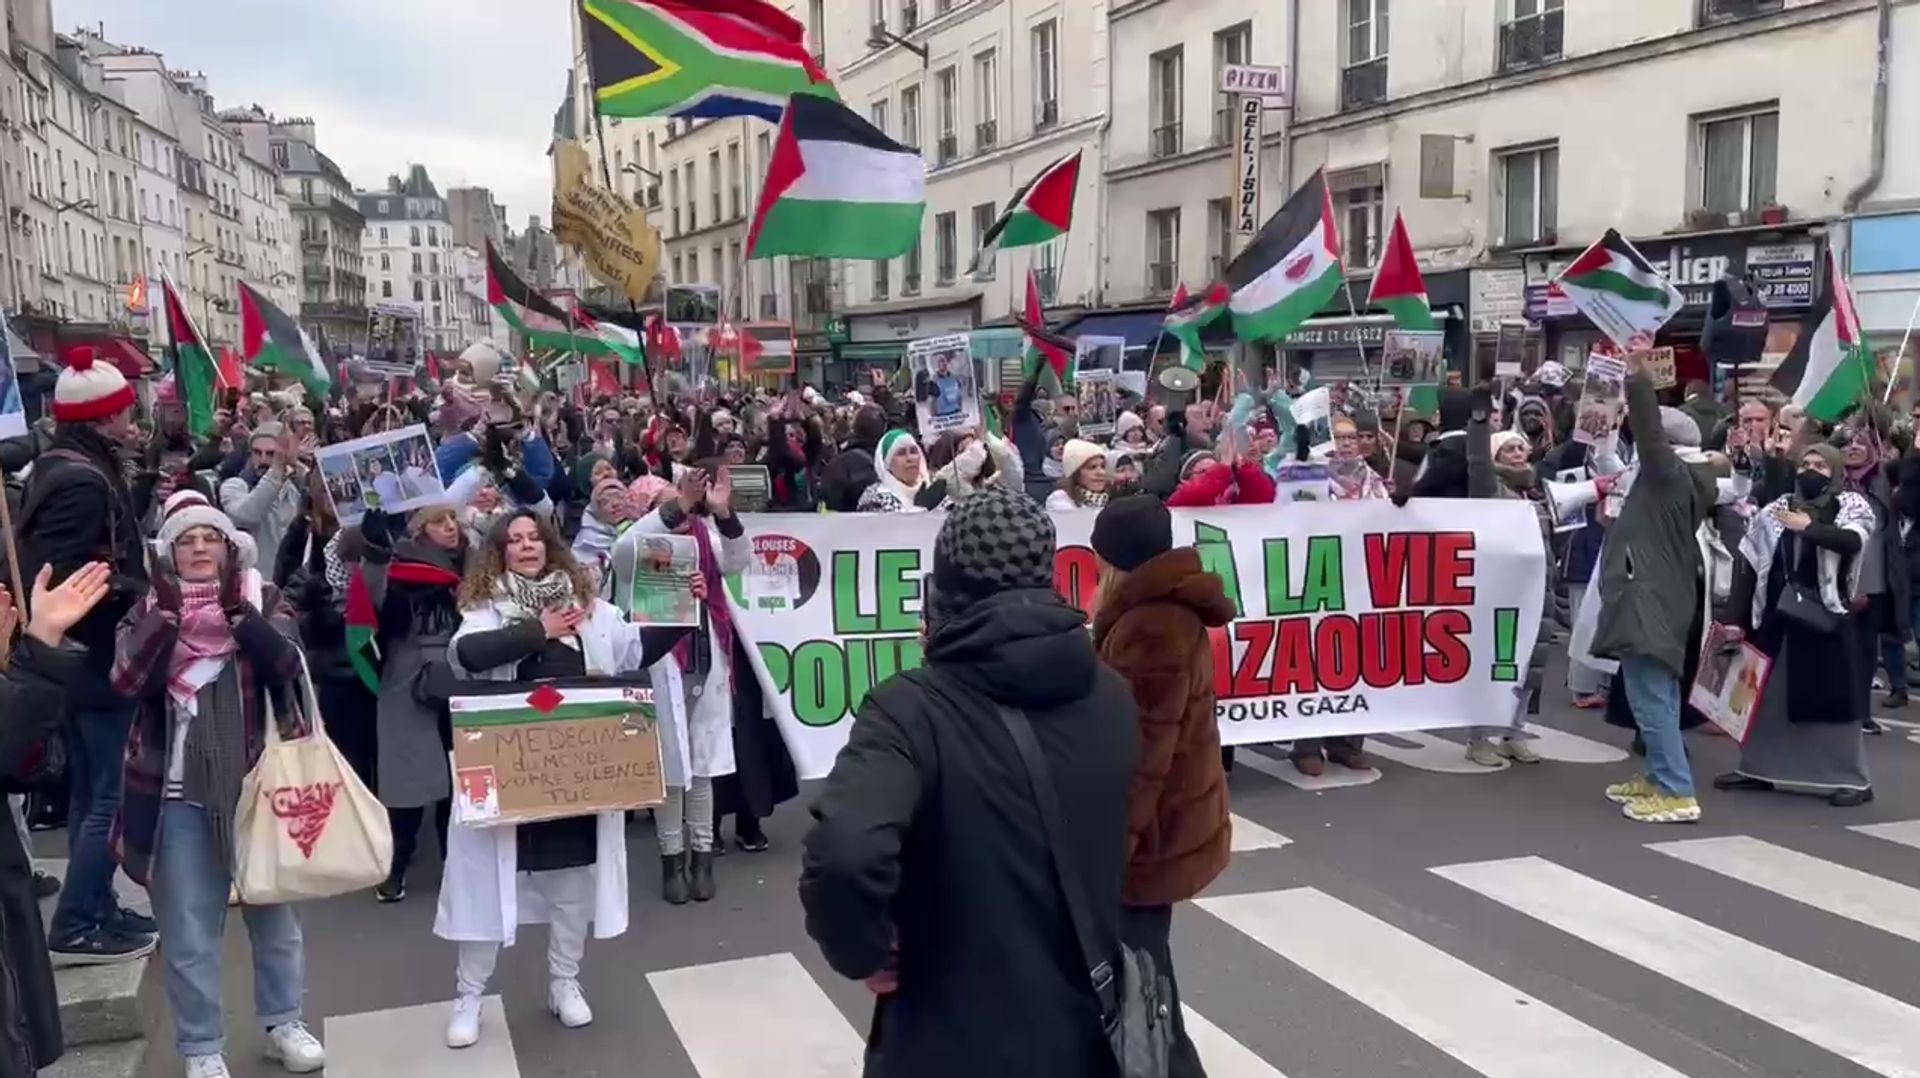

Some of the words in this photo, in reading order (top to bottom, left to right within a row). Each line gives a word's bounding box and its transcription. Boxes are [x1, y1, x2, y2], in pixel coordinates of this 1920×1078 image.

[1226, 69, 1278, 89] PIZZA
[1241, 100, 1258, 232] DELL'ISOLA
[753, 539, 797, 552] LOUSES
[831, 548, 923, 635] LE
[1262, 535, 1346, 617] LA
[1363, 531, 1476, 609] VIE
[1490, 607, 1520, 682] !
[1297, 694, 1370, 716] GAZA
[495, 727, 629, 757] MEDECINS
[573, 762, 658, 785] SILENCE
[545, 788, 592, 804] TUE
